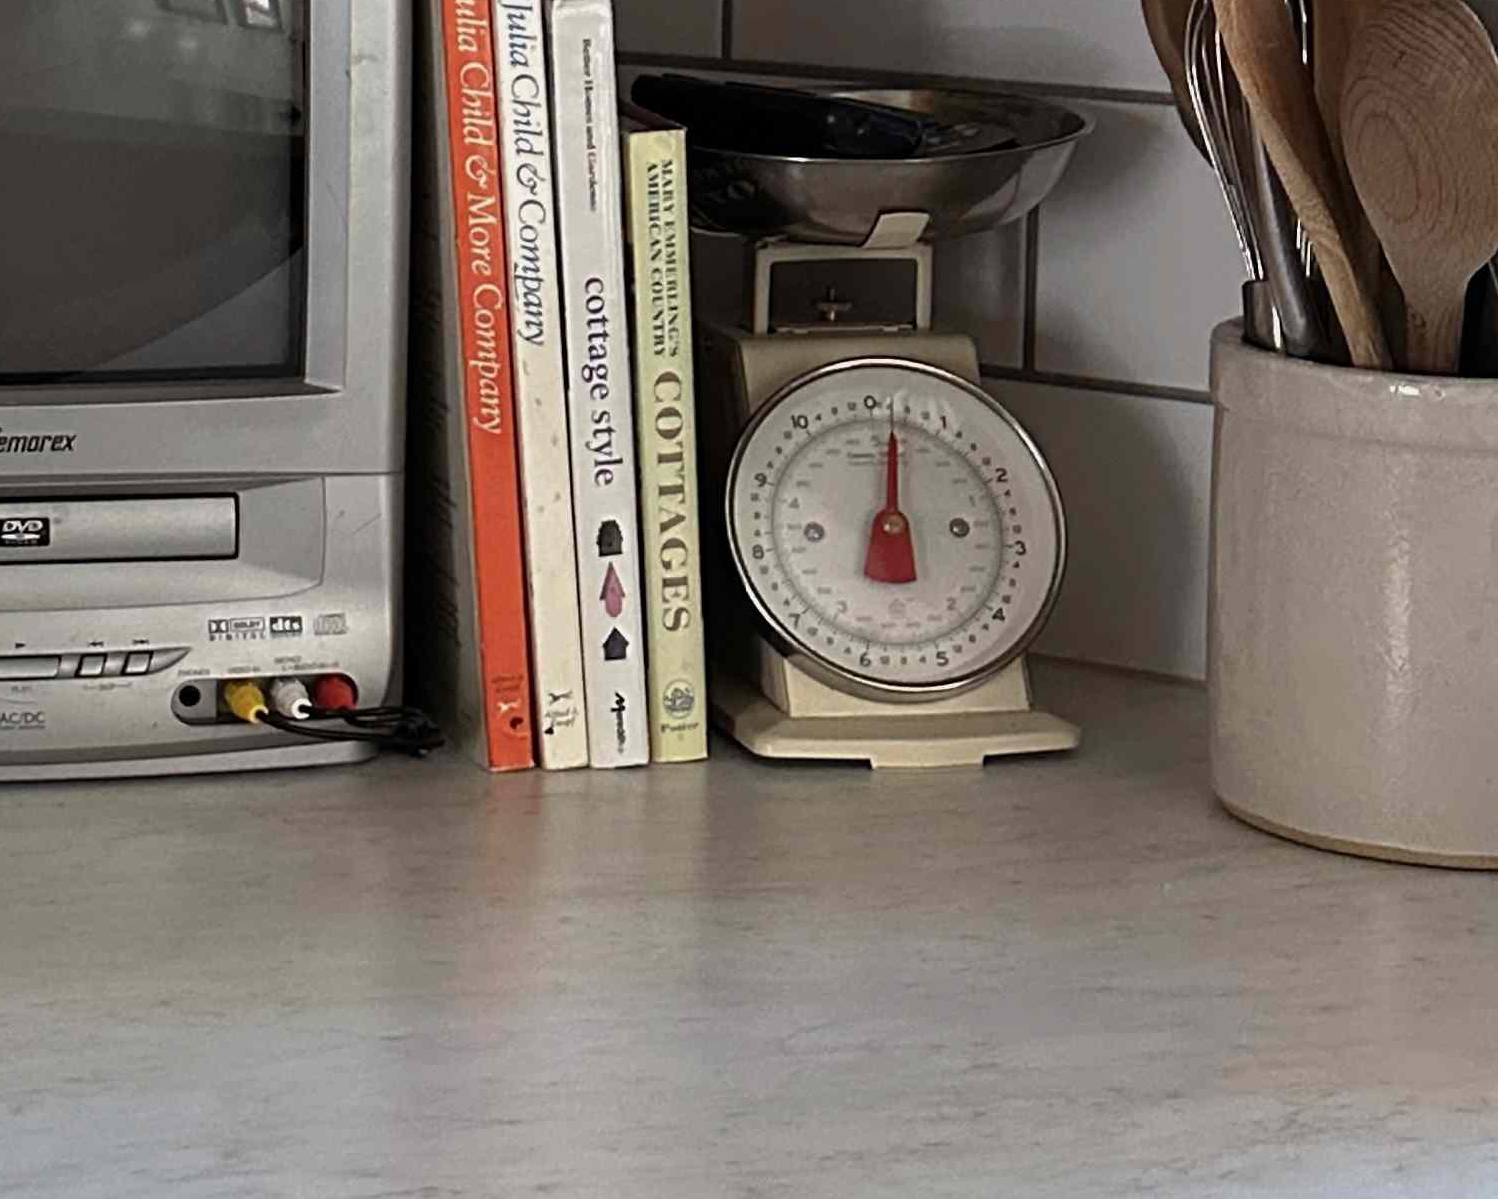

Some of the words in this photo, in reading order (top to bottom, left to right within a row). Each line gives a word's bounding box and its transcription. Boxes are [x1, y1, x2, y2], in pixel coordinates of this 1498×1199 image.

[460, 62, 494, 146] Child
[511, 73, 544, 156] Child
[465, 154, 496, 189] &
[516, 163, 545, 196] &
[661, 159, 675, 212] MARY
[647, 162, 662, 261] AMERICAN
[467, 192, 498, 276] More
[514, 199, 548, 346] Company
[663, 221, 679, 358] EMMERLING'S
[651, 268, 665, 356] COUNTRY
[581, 277, 610, 401] cottage
[469, 283, 503, 434] Company
[863, 395, 876, 409] 0
[791, 414, 809, 429] 10
[940, 416, 947, 429] 1
[585, 409, 623, 487] style
[754, 473, 767, 487] 9
[996, 468, 1008, 482] 2
[653, 371, 691, 632] COTTAGES
[2, 520, 43, 532] DVD
[1014, 540, 1026, 555] 3
[272, 617, 300, 631] dts
[788, 613, 801, 629] 7
[992, 607, 1005, 621] 4
[859, 652, 871, 666] 6
[936, 651, 949, 666] 5
[0, 711, 46, 725] AC/DC
